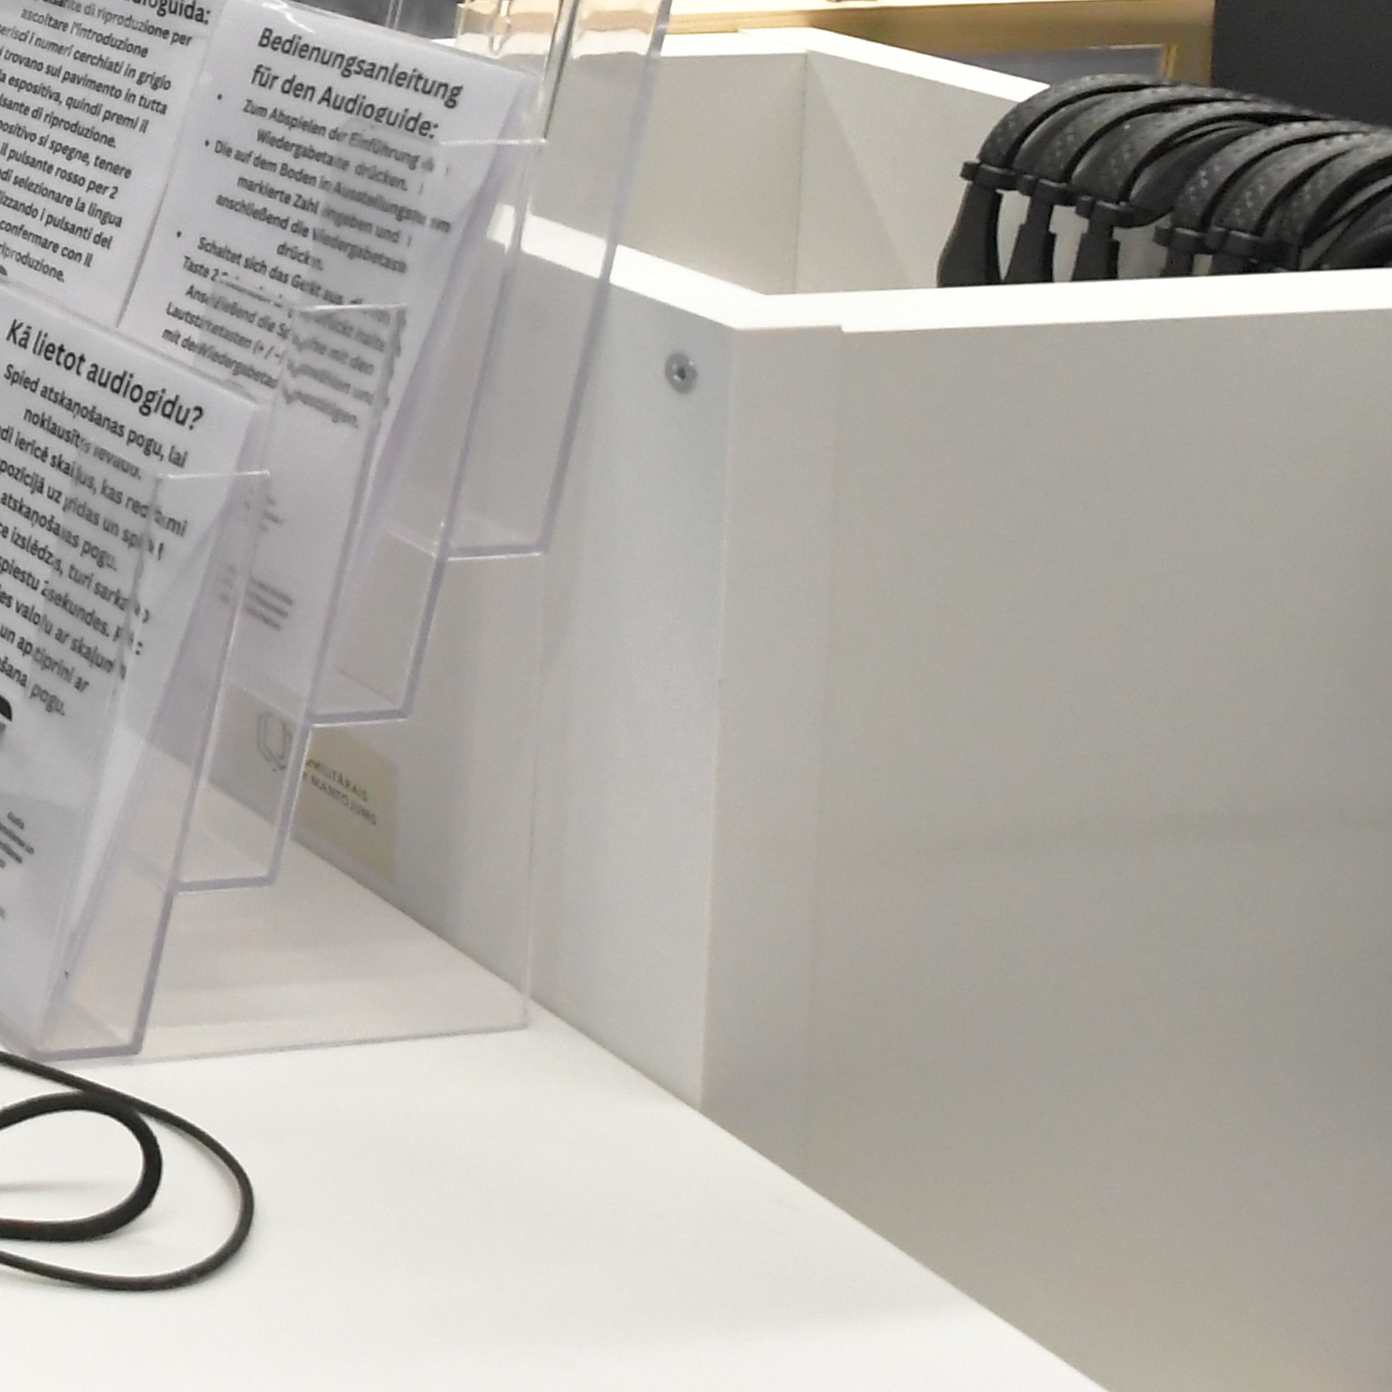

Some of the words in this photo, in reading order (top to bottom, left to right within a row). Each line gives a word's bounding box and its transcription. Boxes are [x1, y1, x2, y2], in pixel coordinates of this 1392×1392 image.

[3, 49, 44, 72] trovano
[44, 64, 63, 78] sul
[61, 71, 123, 99] pavimento
[123, 88, 137, 104] in
[138, 95, 168, 115] tutta
[258, 27, 463, 109] Bedienungsanleitung
[8, 76, 63, 106] espositiva,
[65, 96, 103, 117] quindi
[101, 109, 140, 129] premi
[138, 119, 149, 134] il
[31, 107, 44, 120] di
[43, 111, 116, 148] riproduzione.
[251, 64, 280, 90] für
[280, 74, 316, 102] den
[317, 86, 439, 140] Audioguide:
[0, 142, 9, 157] il
[6, 149, 54, 175] pulsante
[54, 167, 86, 187] rosso
[85, 180, 110, 195] per
[109, 186, 119, 200] 2
[37, 134, 50, 147] si
[48, 140, 90, 167] spegne,
[93, 155, 132, 179] tenere
[12, 175, 74, 207] selezionare
[74, 197, 86, 213] la
[87, 202, 123, 228] lingua
[6, 319, 32, 350] Kā
[32, 330, 86, 376] lietot
[86, 363, 204, 430] audiogidu?
[4, 364, 40, 394] Spied
[40, 385, 125, 438] atskaņošanas
[126, 429, 164, 462] pogu,
